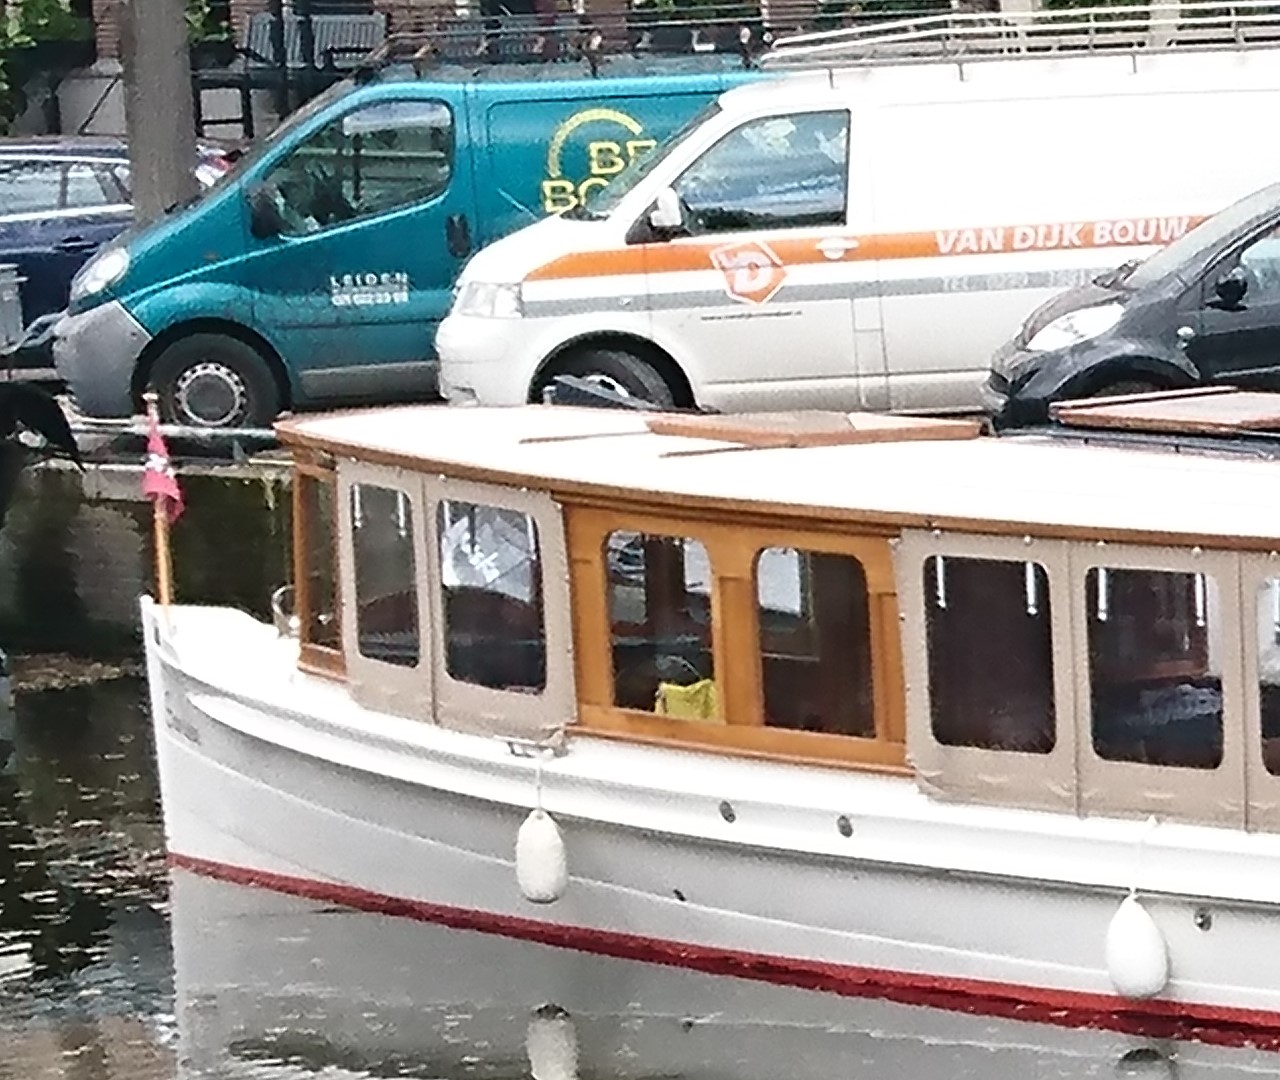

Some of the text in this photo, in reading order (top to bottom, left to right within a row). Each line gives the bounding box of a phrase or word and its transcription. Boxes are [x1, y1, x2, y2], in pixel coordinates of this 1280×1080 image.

[934, 227, 1005, 254] VAN
[1011, 222, 1085, 249] DIJK
[1092, 217, 1191, 246] BOUW
